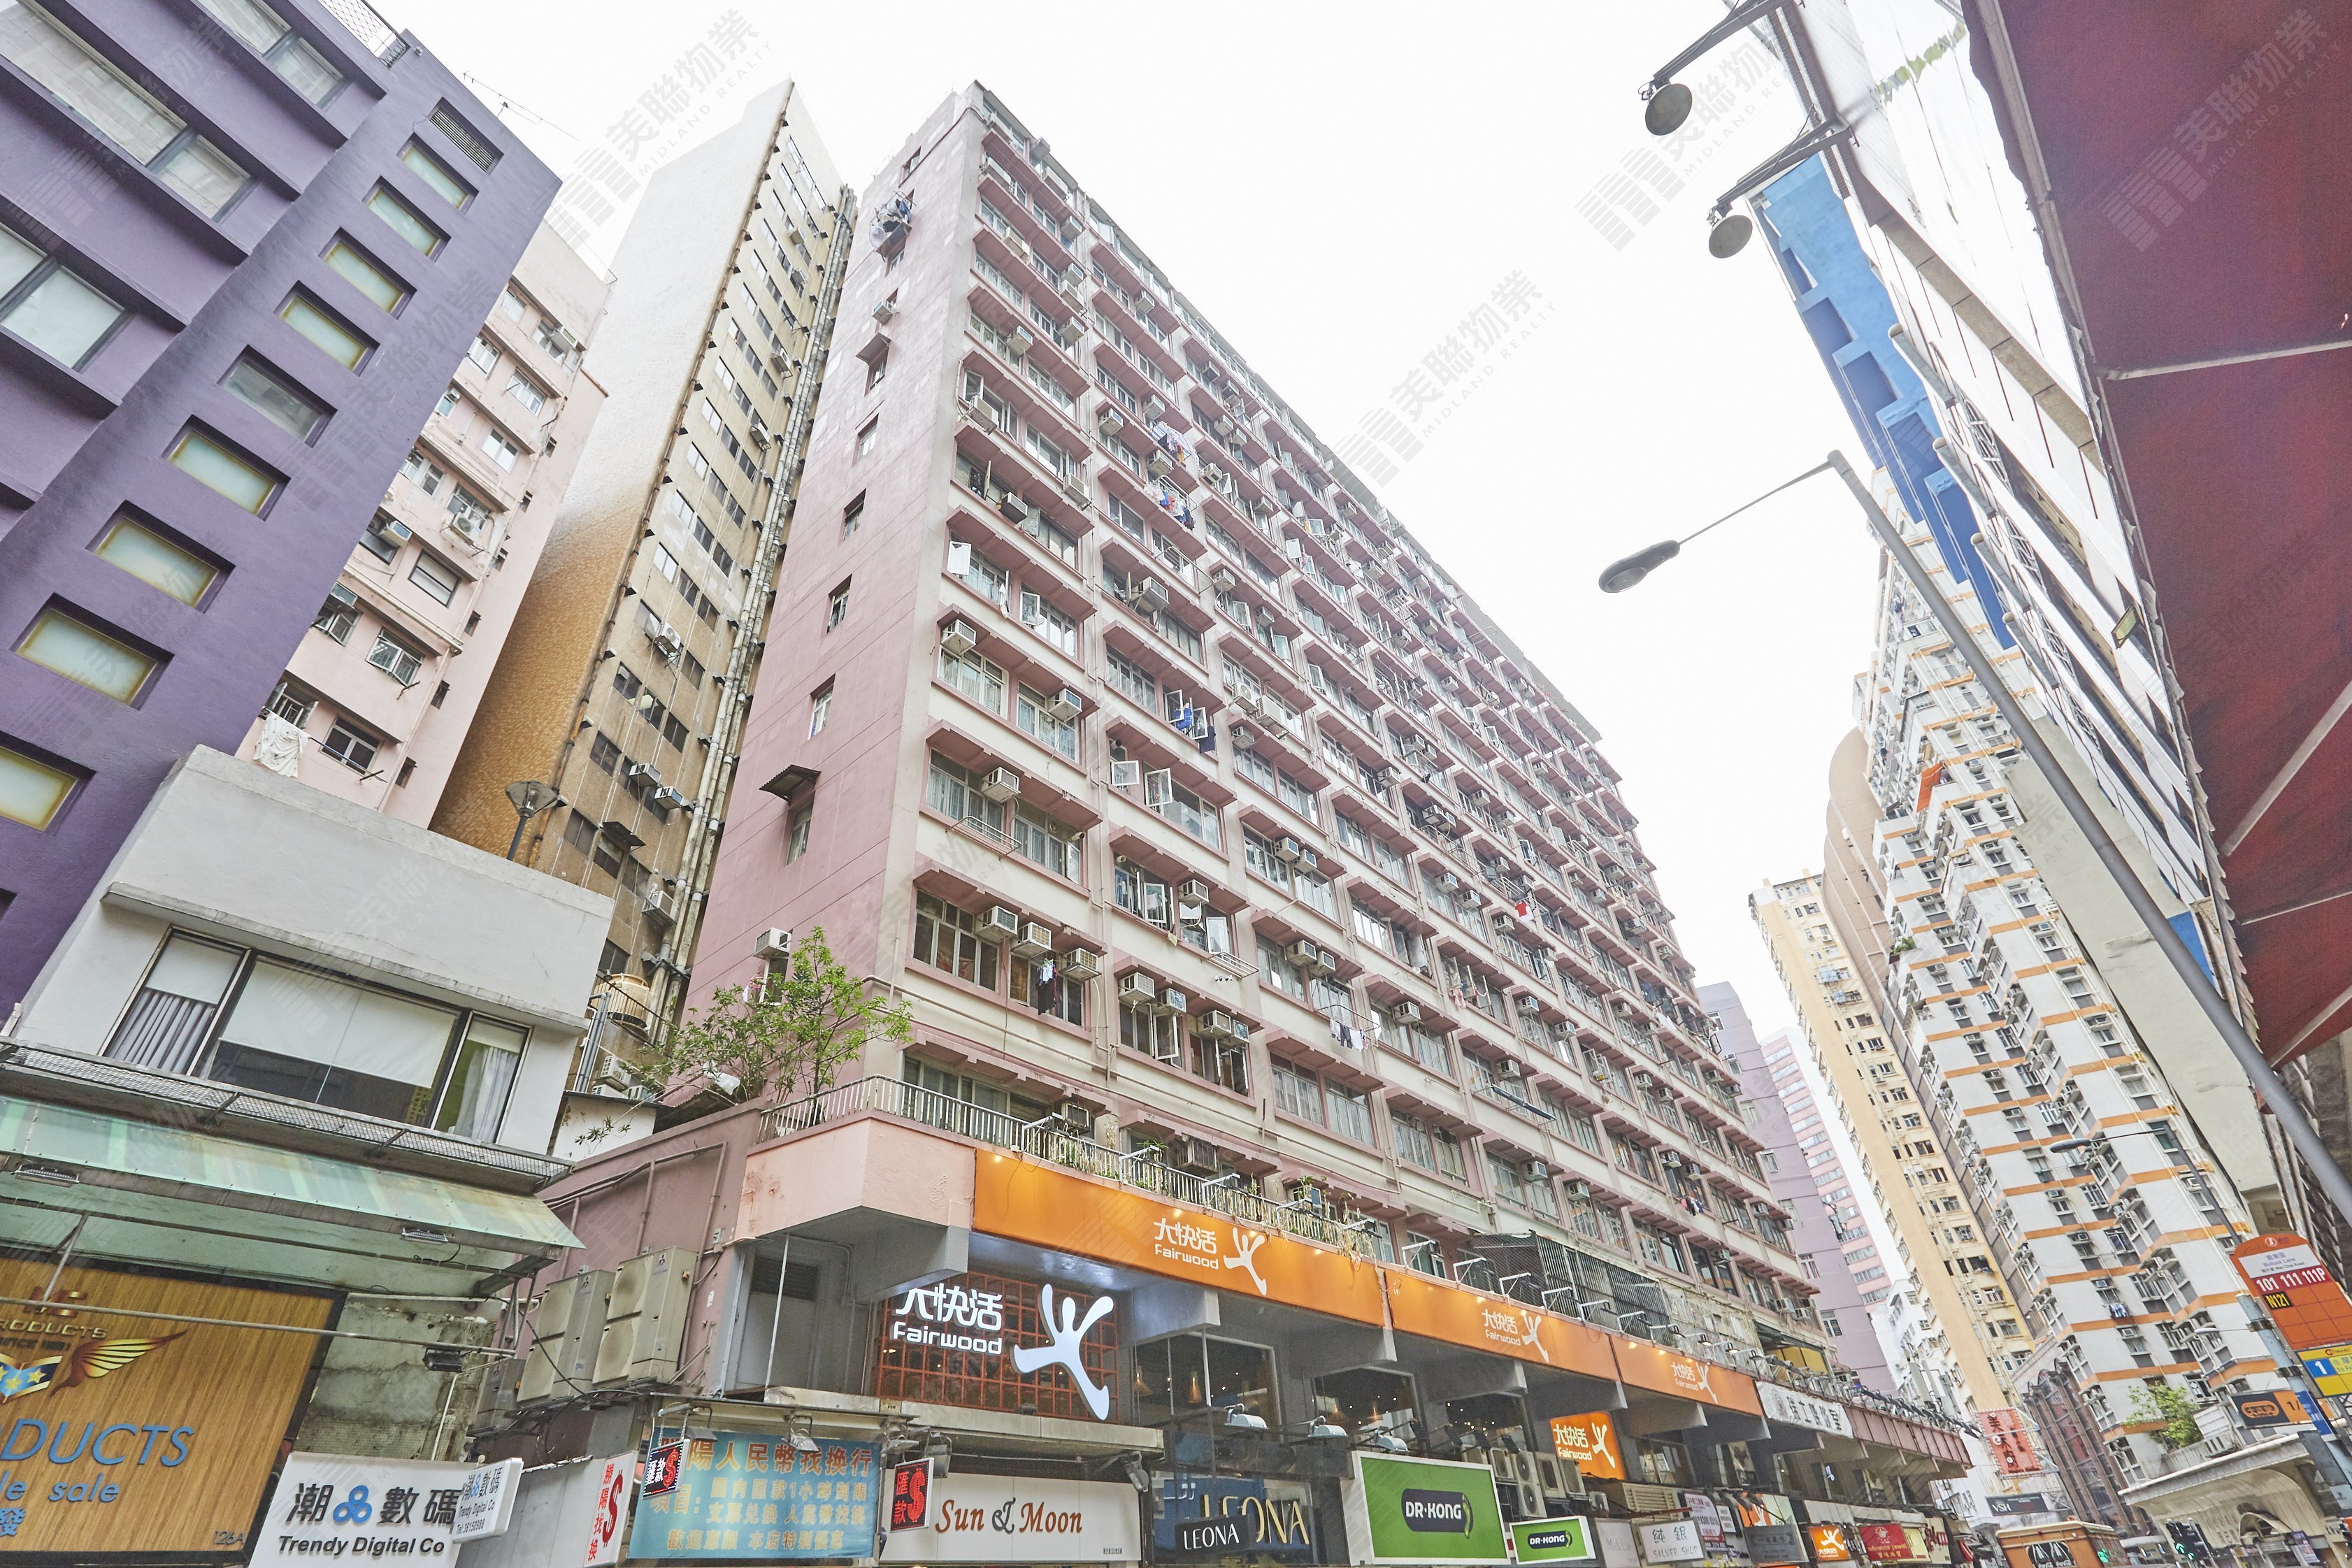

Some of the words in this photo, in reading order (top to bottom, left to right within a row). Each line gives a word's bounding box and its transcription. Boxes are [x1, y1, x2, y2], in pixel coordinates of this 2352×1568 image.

[1154, 1218, 1217, 1254] 大快活
[1155, 1244, 1219, 1269] Fairwood
[2256, 1276, 2279, 1292] 101
[2280, 1272, 2302, 1287] 111
[2302, 1267, 2325, 1283] 111P
[895, 1283, 1003, 1331] 大快活
[2266, 1293, 2290, 1309] N121
[1482, 1309, 1518, 1335] 大快活
[893, 1321, 1002, 1355] Fairwood
[1485, 1330, 1521, 1346] Fairwood
[2315, 1361, 2327, 1374] 1
[0, 1418, 194, 1467] DUCTS
[1554, 1424, 1589, 1448] 大快活
[1558, 1446, 1592, 1460] Fairwood
[48, 1472, 120, 1502] sale
[935, 1499, 984, 1534] Sun
[991, 1497, 1017, 1534] &
[1019, 1502, 1082, 1534] Moon
[213, 1531, 245, 1546] 126A
[279, 1535, 349, 1555] Trendy
[352, 1537, 416, 1557] Digital
[420, 1538, 445, 1553] Co
[1184, 1523, 1240, 1550] LEONA
[1654, 1548, 1677, 1559] SILVER
[1681, 1546, 1698, 1555] SHOP
